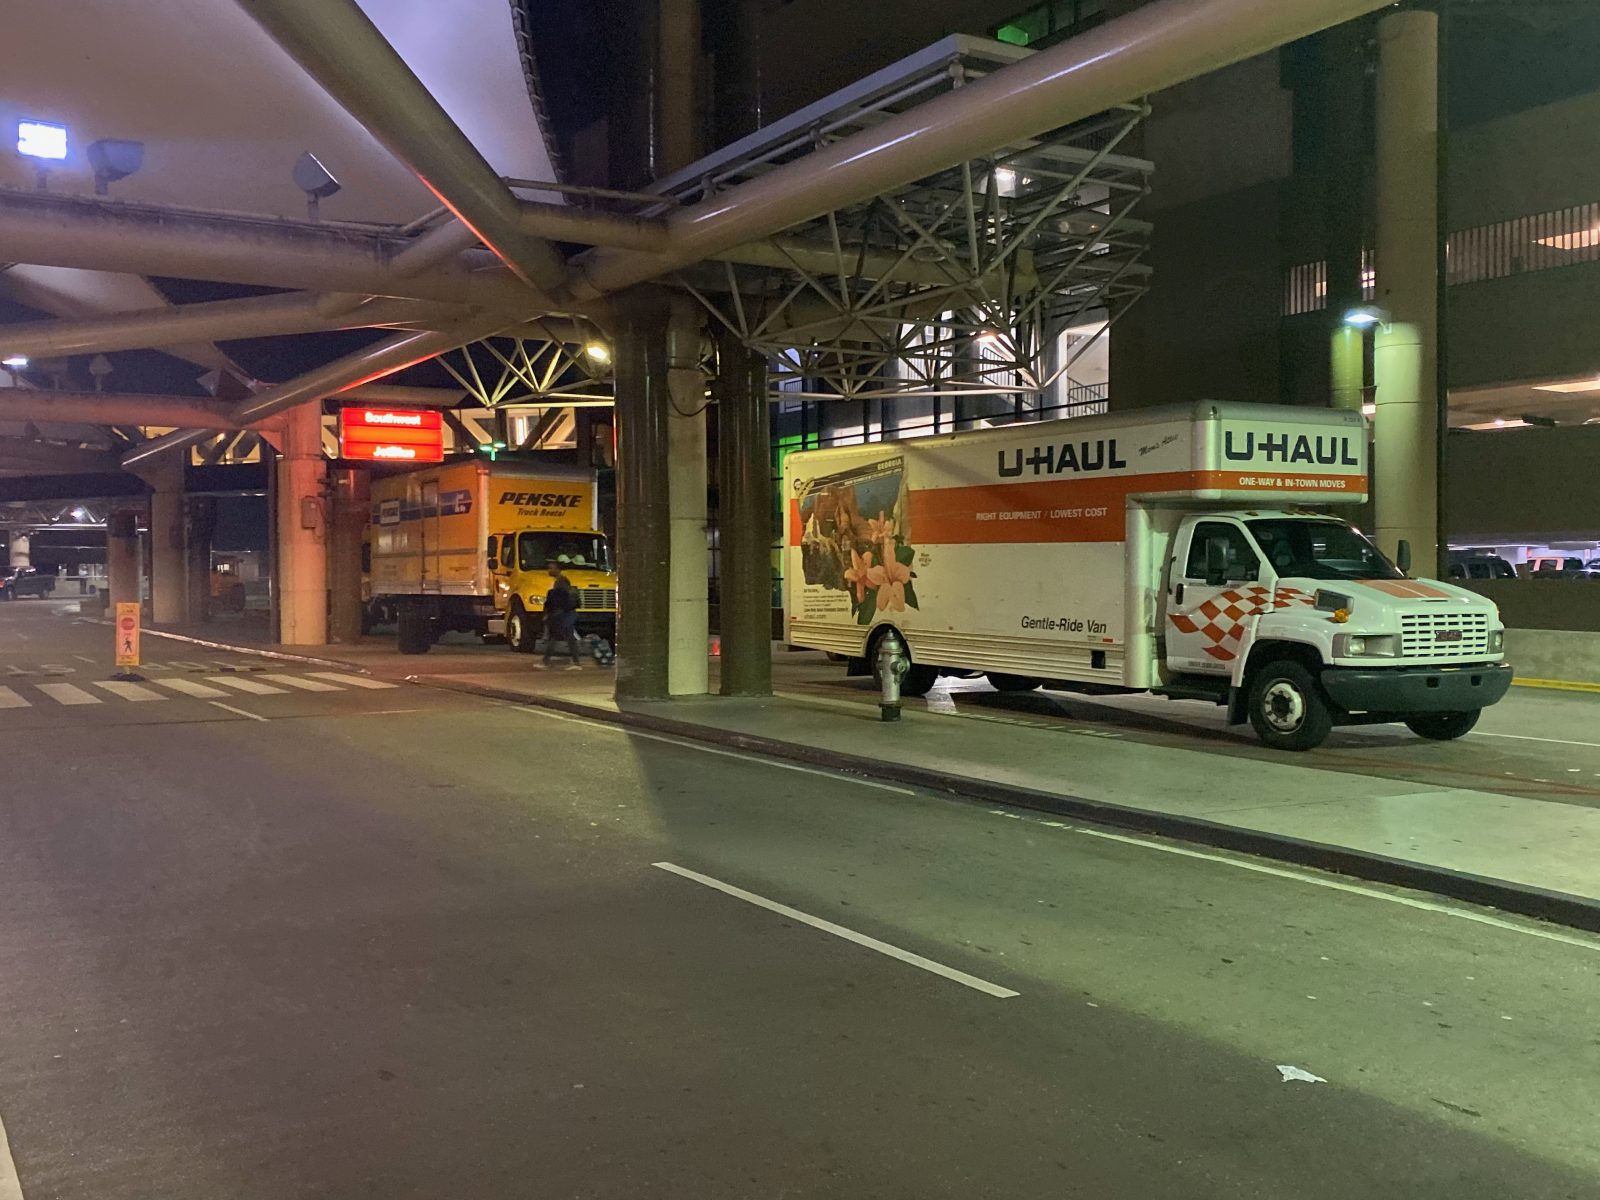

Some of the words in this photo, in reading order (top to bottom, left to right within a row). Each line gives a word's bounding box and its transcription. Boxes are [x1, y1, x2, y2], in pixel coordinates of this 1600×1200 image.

[877, 458, 902, 470] GEORGIA
[1239, 477, 1274, 486] ONE-WAY
[1276, 478, 1282, 487] &
[1285, 479, 1318, 488] IN-TOWN
[1320, 480, 1346, 488] MOVES
[499, 492, 583, 507] PENSKE
[518, 508, 538, 516] Truck
[541, 508, 566, 517] Rental
[976, 512, 996, 520] RIGHT
[999, 510, 1041, 520] EQUIPMENT
[1050, 508, 1082, 519] LOWEST
[1085, 507, 1108, 517] COST
[1021, 615, 1084, 632] Gentle-Ride
[1087, 619, 1107, 633] Van
